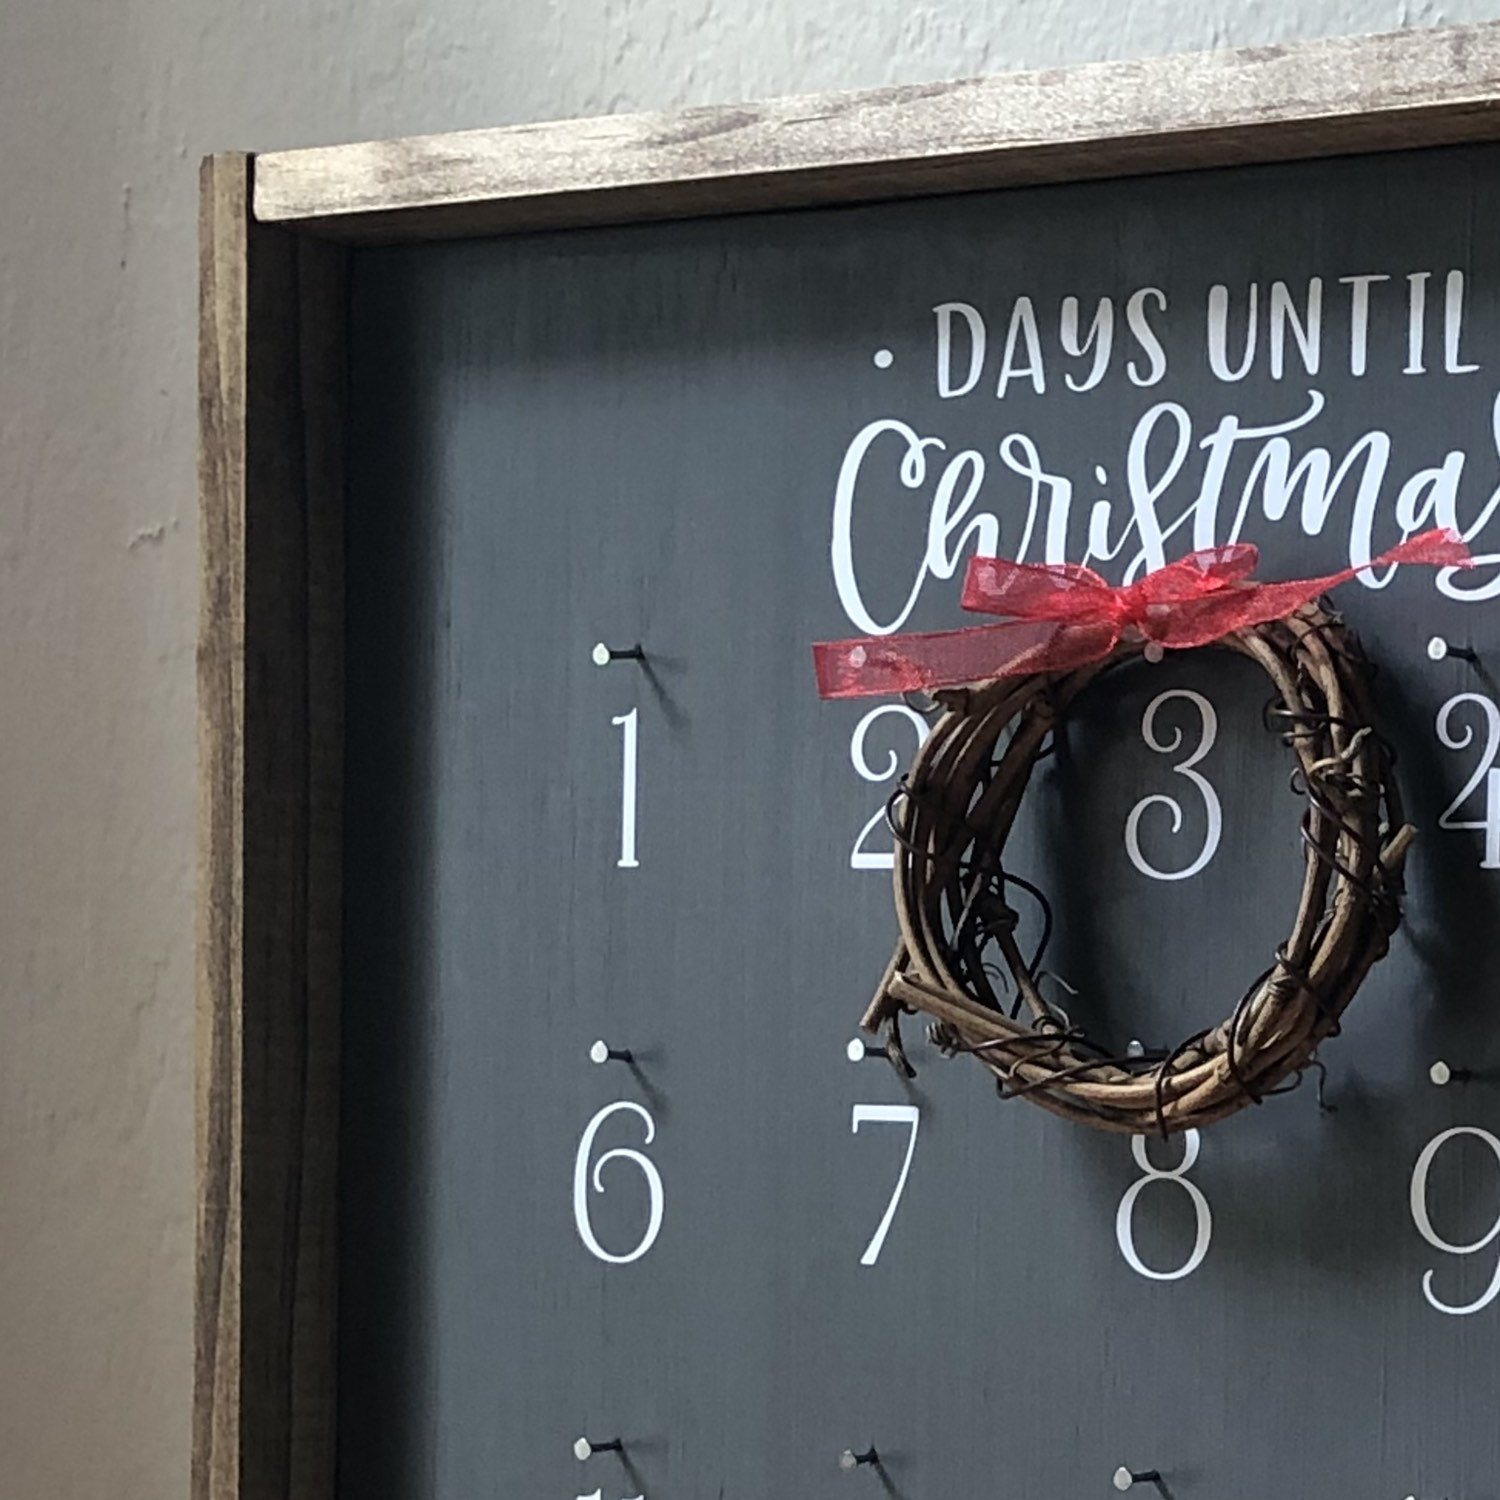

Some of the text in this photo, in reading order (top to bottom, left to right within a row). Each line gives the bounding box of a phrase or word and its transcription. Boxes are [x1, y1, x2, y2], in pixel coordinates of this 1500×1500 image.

[932, 270, 1480, 398] DAYS UNTIL
[611, 707, 640, 868] 1
[850, 704, 931, 869] 2
[1125, 689, 1222, 881] 3
[573, 1100, 664, 1264] 6
[851, 1103, 920, 1266] 7
[1116, 1127, 1212, 1281] 8
